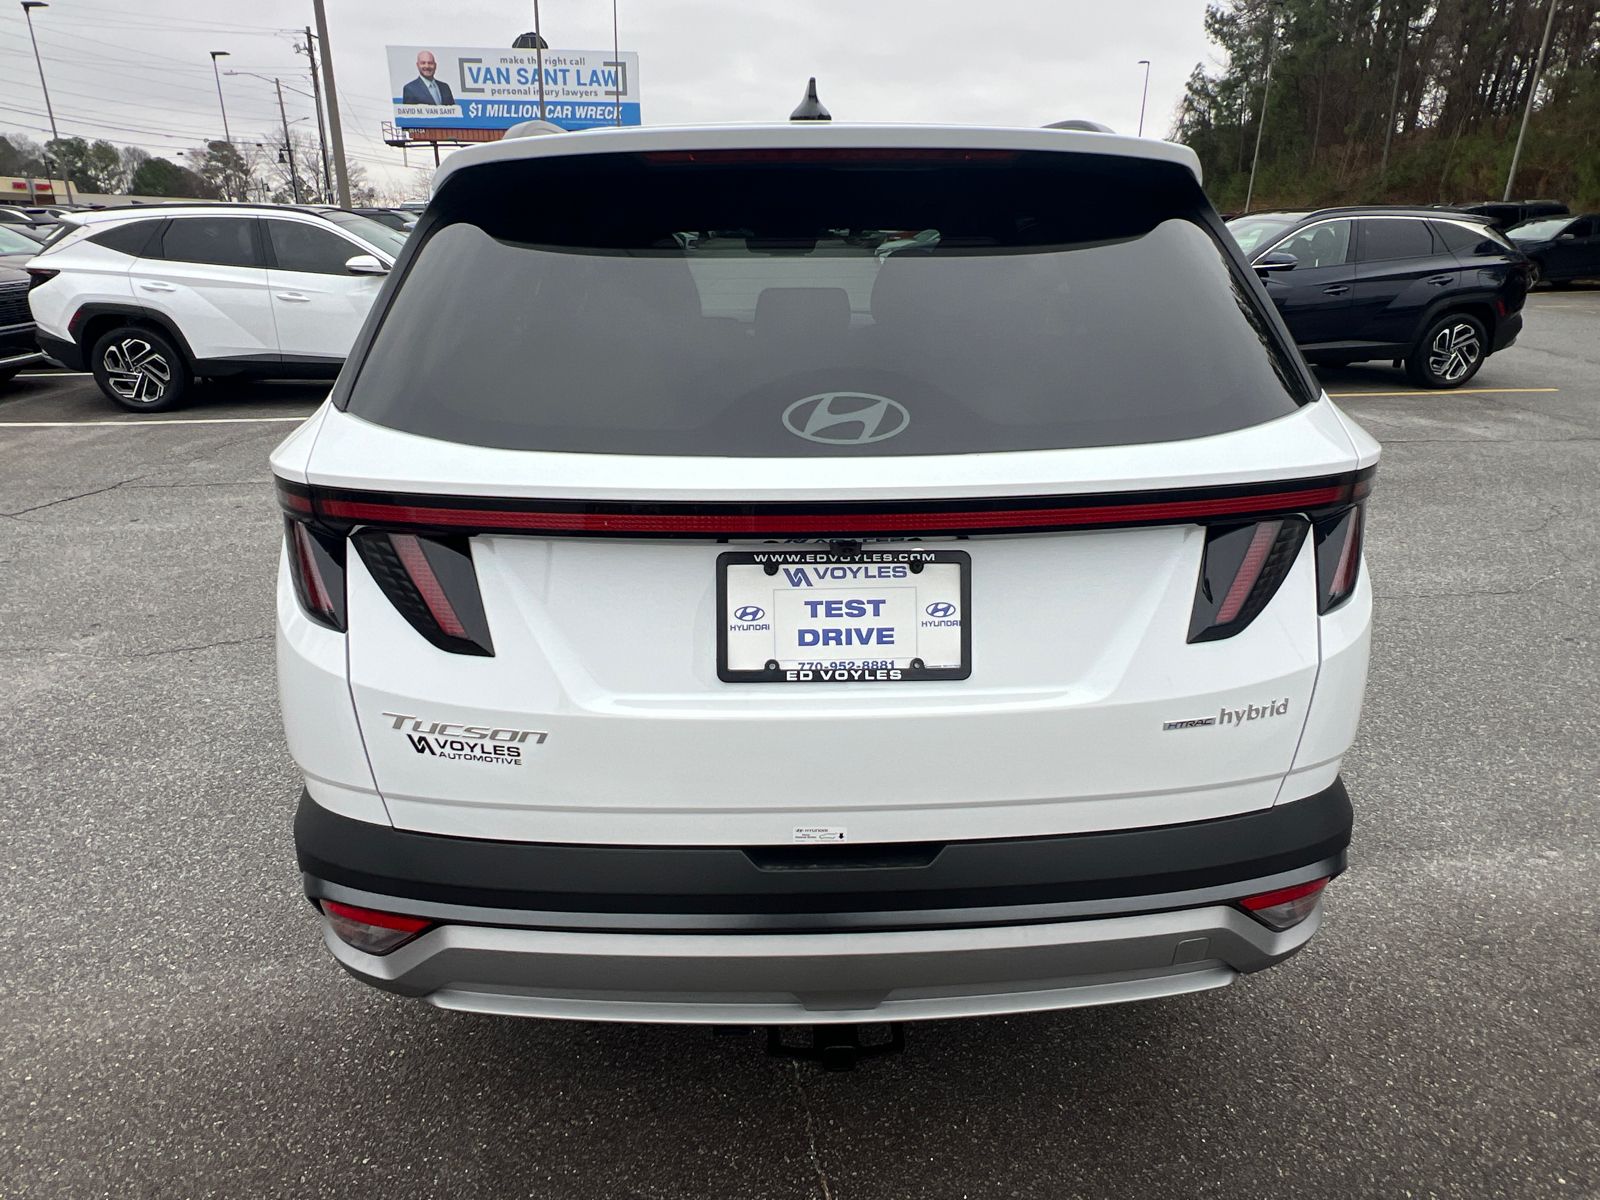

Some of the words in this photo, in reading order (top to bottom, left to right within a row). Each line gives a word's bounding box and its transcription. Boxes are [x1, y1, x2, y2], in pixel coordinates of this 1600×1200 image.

[499, 56, 525, 65] make
[527, 56, 541, 65] th
[544, 57, 568, 68] right
[569, 57, 586, 66] call
[467, 66, 511, 85] VAN
[516, 67, 570, 87] SANT
[576, 69, 618, 88] LAW
[490, 87, 531, 97] personal
[562, 88, 599, 99] lawyers
[397, 107, 416, 115] DAVID
[416, 107, 424, 115] M.
[468, 102, 482, 119] $1
[485, 104, 542, 118] MILLION
[545, 105, 573, 119] CAR
[574, 105, 623, 120] WRECK
[813, 566, 908, 580] VOYLES
[804, 599, 886, 618] TEST
[729, 623, 770, 631] HYUNDAI
[921, 619, 962, 627] HYUNDAI
[797, 627, 895, 647] DRIVE
[798, 660, 895, 670] 770-952-8881
[786, 670, 813, 681] ED
[819, 669, 902, 680] VOYLES
[1166, 717, 1213, 730] HTRAC
[1218, 697, 1289, 727] hybrid
[434, 737, 522, 758] VOYLES
[438, 751, 522, 766] AUTOMOTIVE
